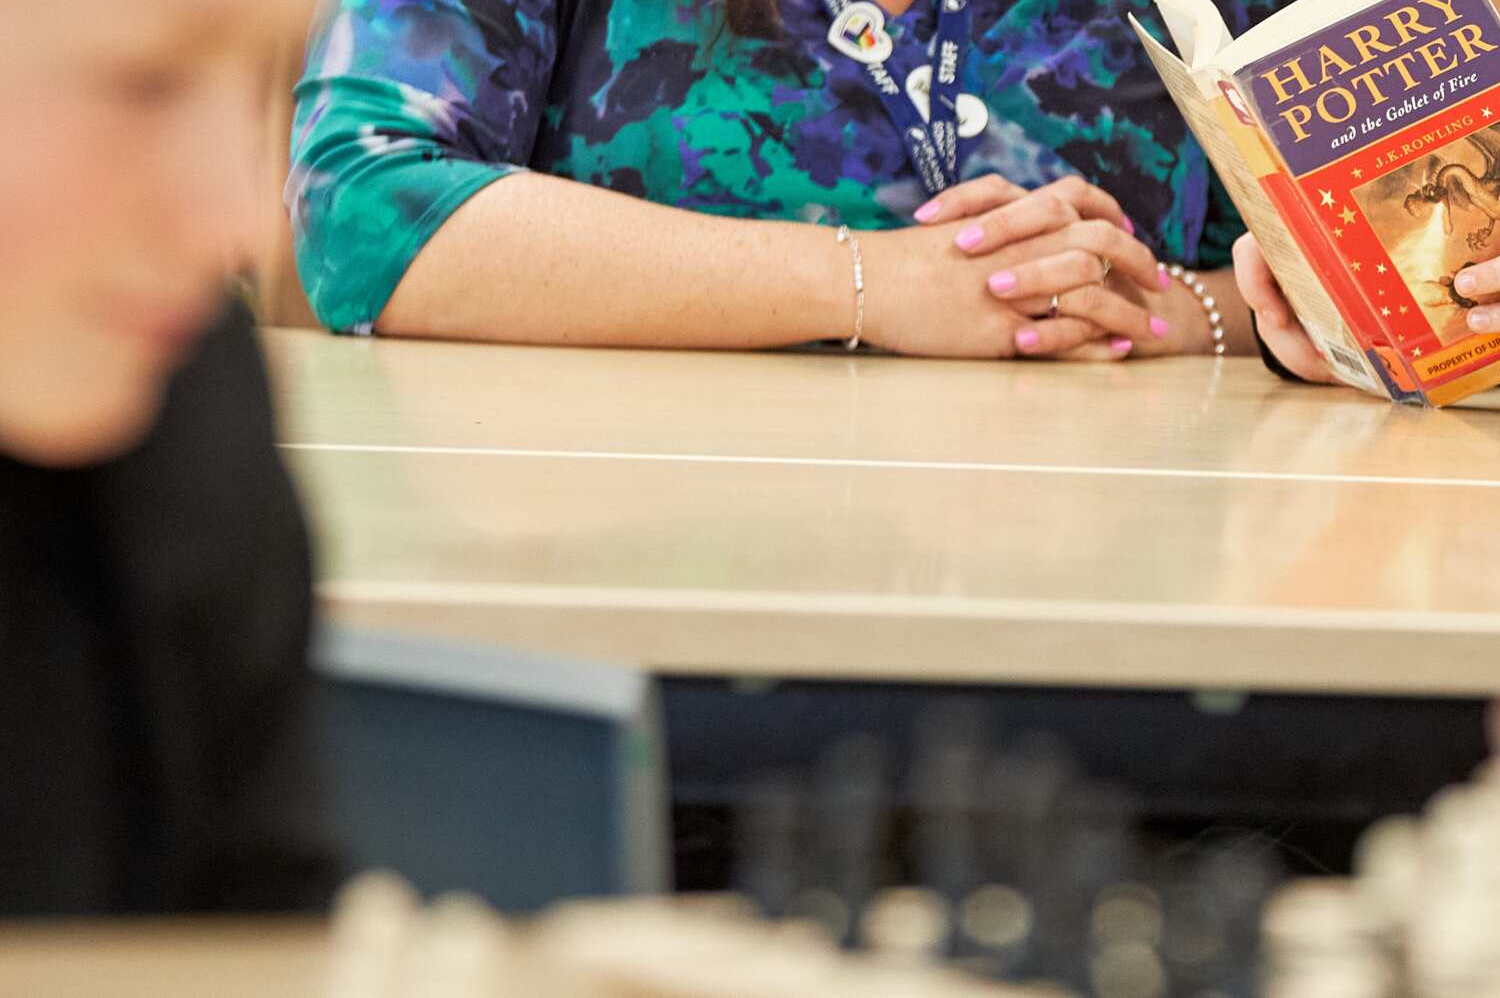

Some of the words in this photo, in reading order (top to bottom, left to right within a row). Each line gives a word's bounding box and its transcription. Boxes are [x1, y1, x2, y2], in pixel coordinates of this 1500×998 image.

[864, 61, 900, 96] TAFF
[1278, 24, 1499, 144] POTTER
[1330, 126, 1357, 149] and
[1361, 117, 1384, 134] the
[1385, 93, 1430, 122] Goblet
[1432, 82, 1446, 102] of
[1448, 73, 1479, 94] Fire
[1426, 350, 1473, 375] PROPERTY
[1474, 344, 1488, 355] OF
